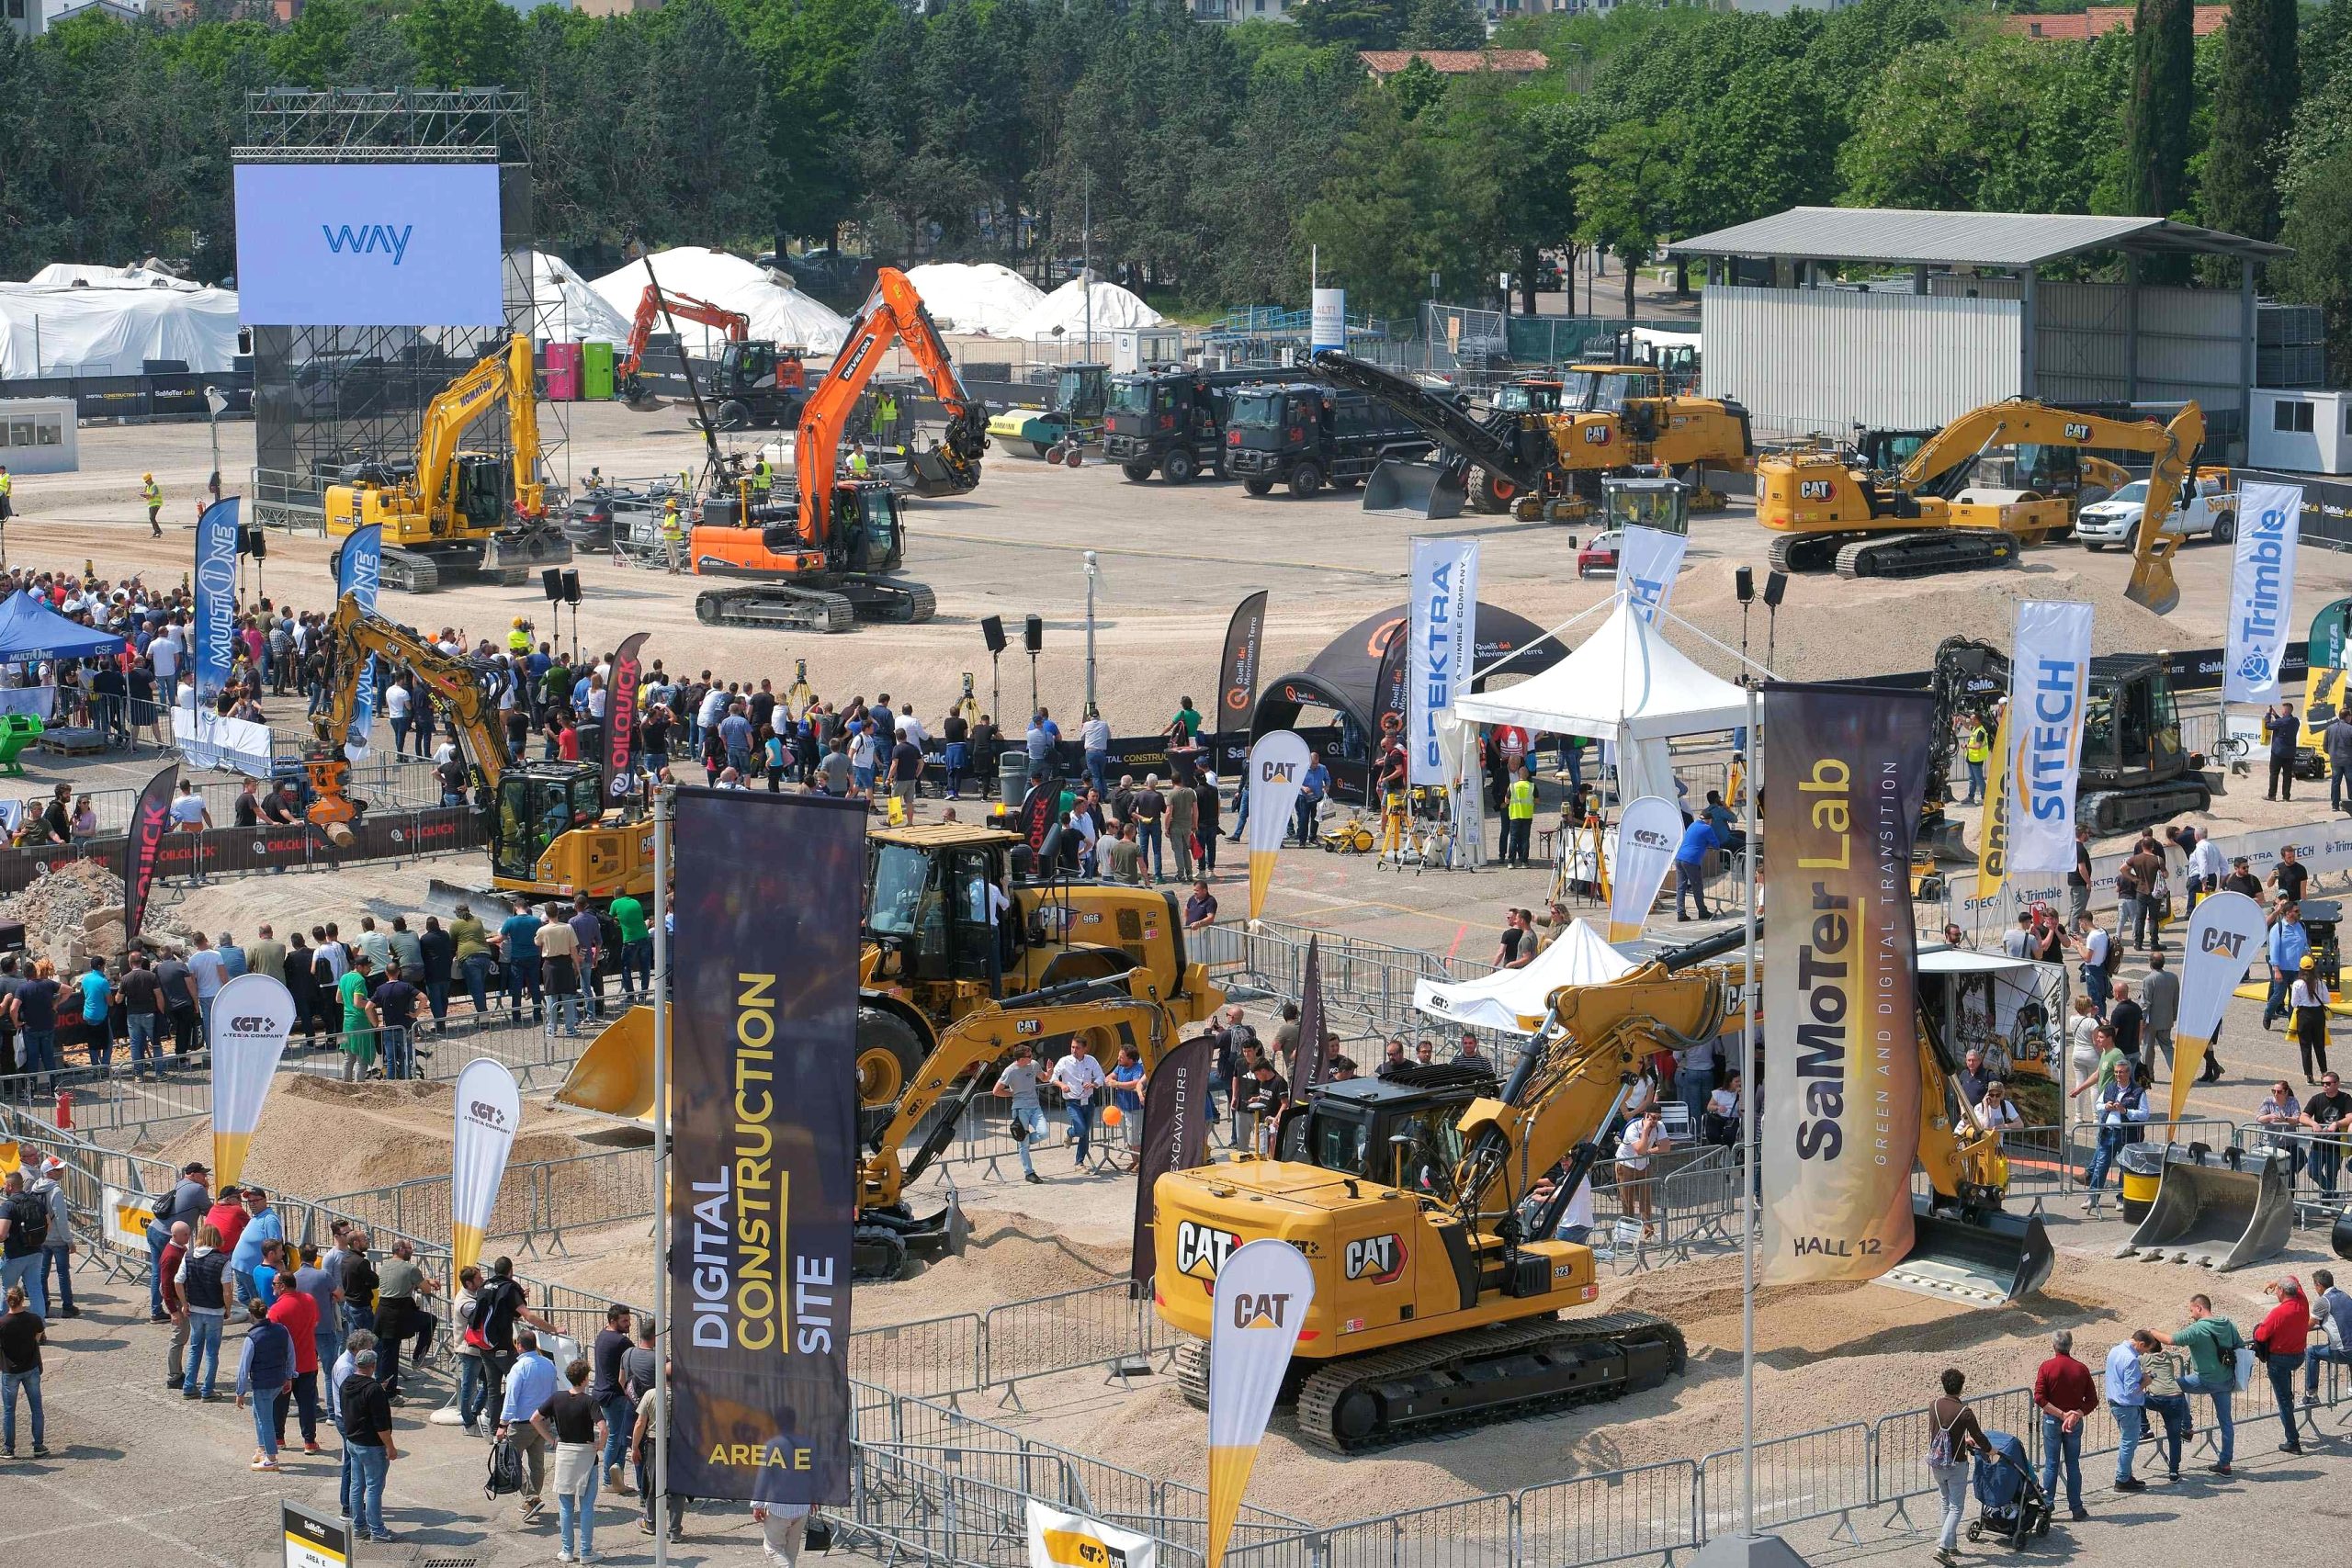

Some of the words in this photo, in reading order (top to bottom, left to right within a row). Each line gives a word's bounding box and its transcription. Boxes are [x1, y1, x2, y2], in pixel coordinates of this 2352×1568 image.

[843, 339, 872, 379] DEVELON
[183, 388, 195, 396] Lab
[460, 378, 492, 407] KOMATSU
[1585, 425, 1606, 443] CAT
[2064, 423, 2089, 440] CAT
[1801, 480, 1828, 499] CAT
[2243, 509, 2286, 643] Trimble
[1457, 561, 1466, 618] COMPANY
[1248, 616, 1257, 638] Terra
[95, 645, 112, 655] CSF
[385, 642, 401, 655] CAT
[1456, 622, 1464, 671] TRIMBLE
[1476, 642, 1499, 651] Quelli
[1498, 641, 1512, 650] del
[1236, 660, 1246, 684] Quelli
[1243, 638, 1255, 687] Movimento
[2171, 666, 2185, 674] SITE
[1394, 669, 1403, 683] del
[428, 693, 445, 711] icon
[1390, 683, 1401, 708] Quelli
[613, 655, 638, 769] OILQUICK
[2033, 660, 2075, 820] SITECH
[1123, 753, 1169, 762] CONSTRUC
[469, 770, 480, 790] icon
[1262, 761, 1295, 784] CAT
[1797, 757, 1851, 871] Lab
[1634, 829, 1659, 845] CGT
[1880, 760, 1897, 907] TRANSITION
[2335, 840, 2352, 853] Trim
[2025, 887, 2063, 903] Trimble
[1039, 906, 1067, 927] CAT
[1083, 914, 1100, 924] 966
[2201, 927, 2246, 959] CAT
[1878, 919, 1894, 1014] DIGITAL
[1430, 995, 1445, 1006] CGT
[231, 1016, 263, 1032] CGT
[1015, 1020, 1038, 1035] CAT
[1796, 880, 1849, 1162] SaMoTer
[1877, 1029, 1891, 1075] AND
[470, 1100, 497, 1120] CGT
[1170, 1066, 1186, 1173] EXCAVATORS
[485, 1122, 511, 1135] COMPANY
[1874, 1089, 1888, 1166] GREEN
[735, 972, 776, 1350] CONSTRUCTION
[692, 1164, 729, 1349] DIGITAL
[1177, 1221, 1234, 1280] CAT
[1346, 1235, 1393, 1280] CAT
[1793, 1235, 1853, 1258] HALL
[1858, 1237, 1882, 1256] 12
[1554, 1266, 1568, 1278] 323
[797, 1255, 833, 1355] SITE
[1234, 1293, 1289, 1329] CAT
[707, 1443, 786, 1470] AREA
[794, 1449, 811, 1470] E
[304, 1520, 326, 1536] SaMoTer
[305, 1553, 320, 1564] AREA
